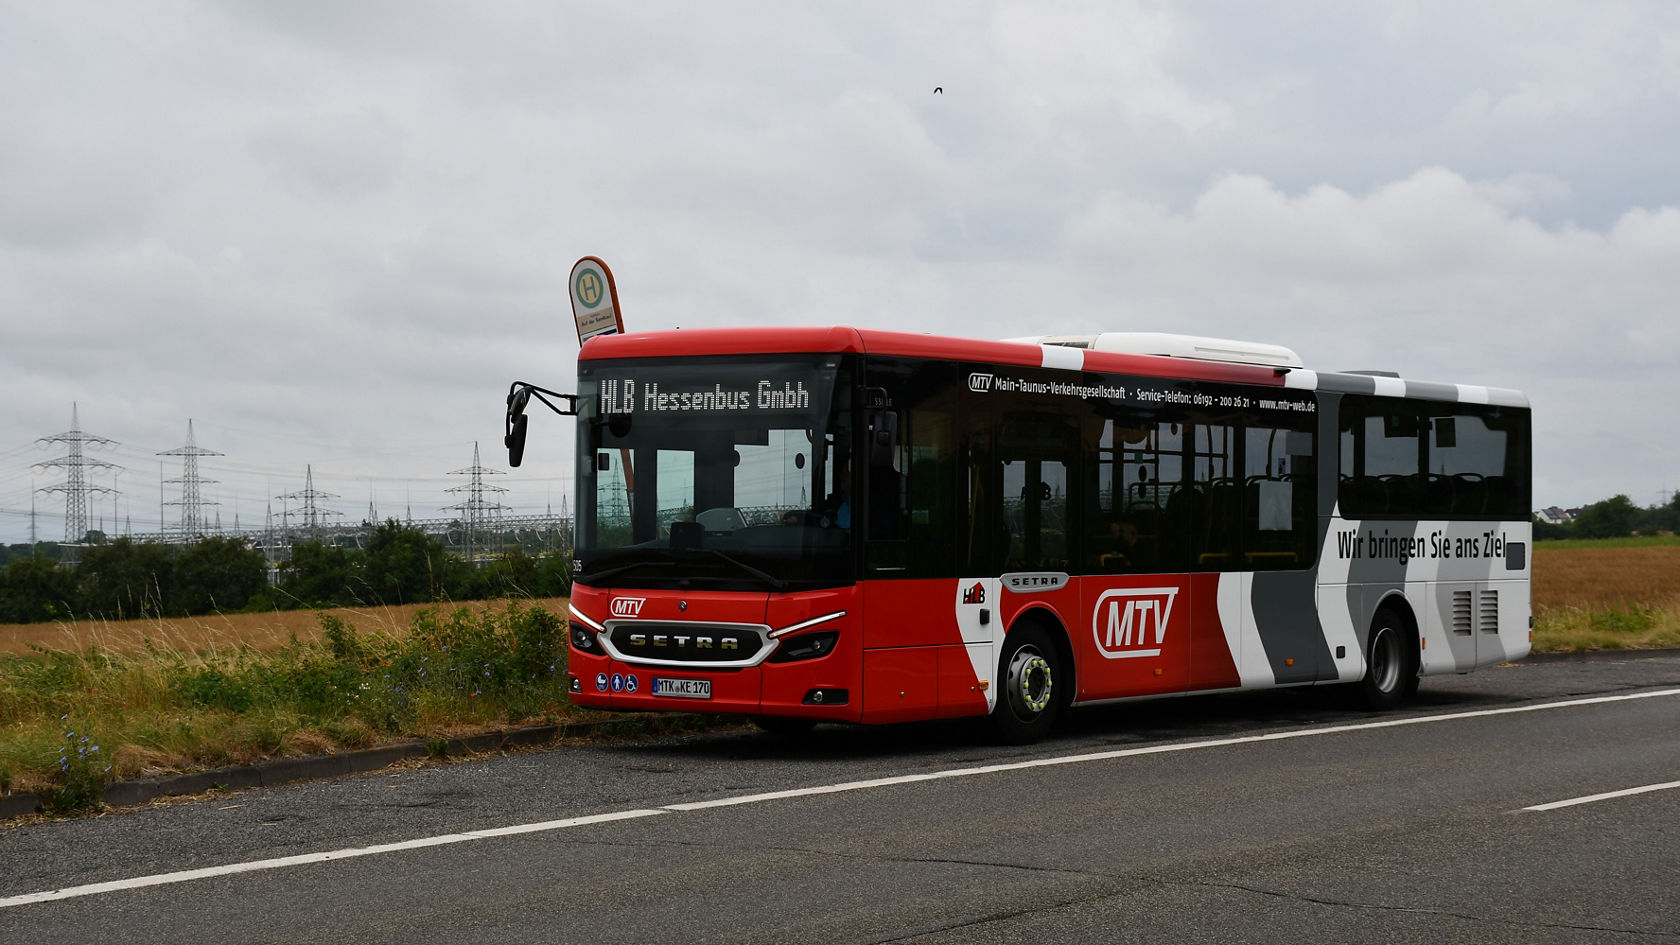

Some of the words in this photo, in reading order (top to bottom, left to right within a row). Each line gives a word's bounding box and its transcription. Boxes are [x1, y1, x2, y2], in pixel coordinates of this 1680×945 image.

[582, 276, 596, 300] H
[601, 379, 635, 414] HLB
[644, 383, 750, 411] Hessenbus
[757, 380, 809, 409] Gmbh
[971, 374, 993, 390] MTV
[995, 377, 1126, 399] Main-Taunus-Verkehrsgesellschaft
[1136, 388, 1192, 404] Service-Telefon:
[1193, 393, 1213, 407] 06192
[1220, 396, 1233, 407] 200
[1233, 396, 1242, 407] 26
[1243, 397, 1250, 408] 21
[1259, 399, 1316, 412] www.mtv-web.de
[1337, 528, 1364, 559] Wir
[1369, 528, 1425, 566] bringen
[1430, 530, 1450, 559] Sie
[1455, 537, 1479, 559] ans
[1483, 530, 1506, 558] Ziel
[1012, 577, 1059, 586] SETRA
[614, 599, 644, 615] MTV
[1104, 597, 1174, 648] MTV
[629, 633, 738, 650] SETRA
[658, 679, 674, 692] MTK
[680, 681, 692, 693] KE
[693, 682, 709, 694] 170
